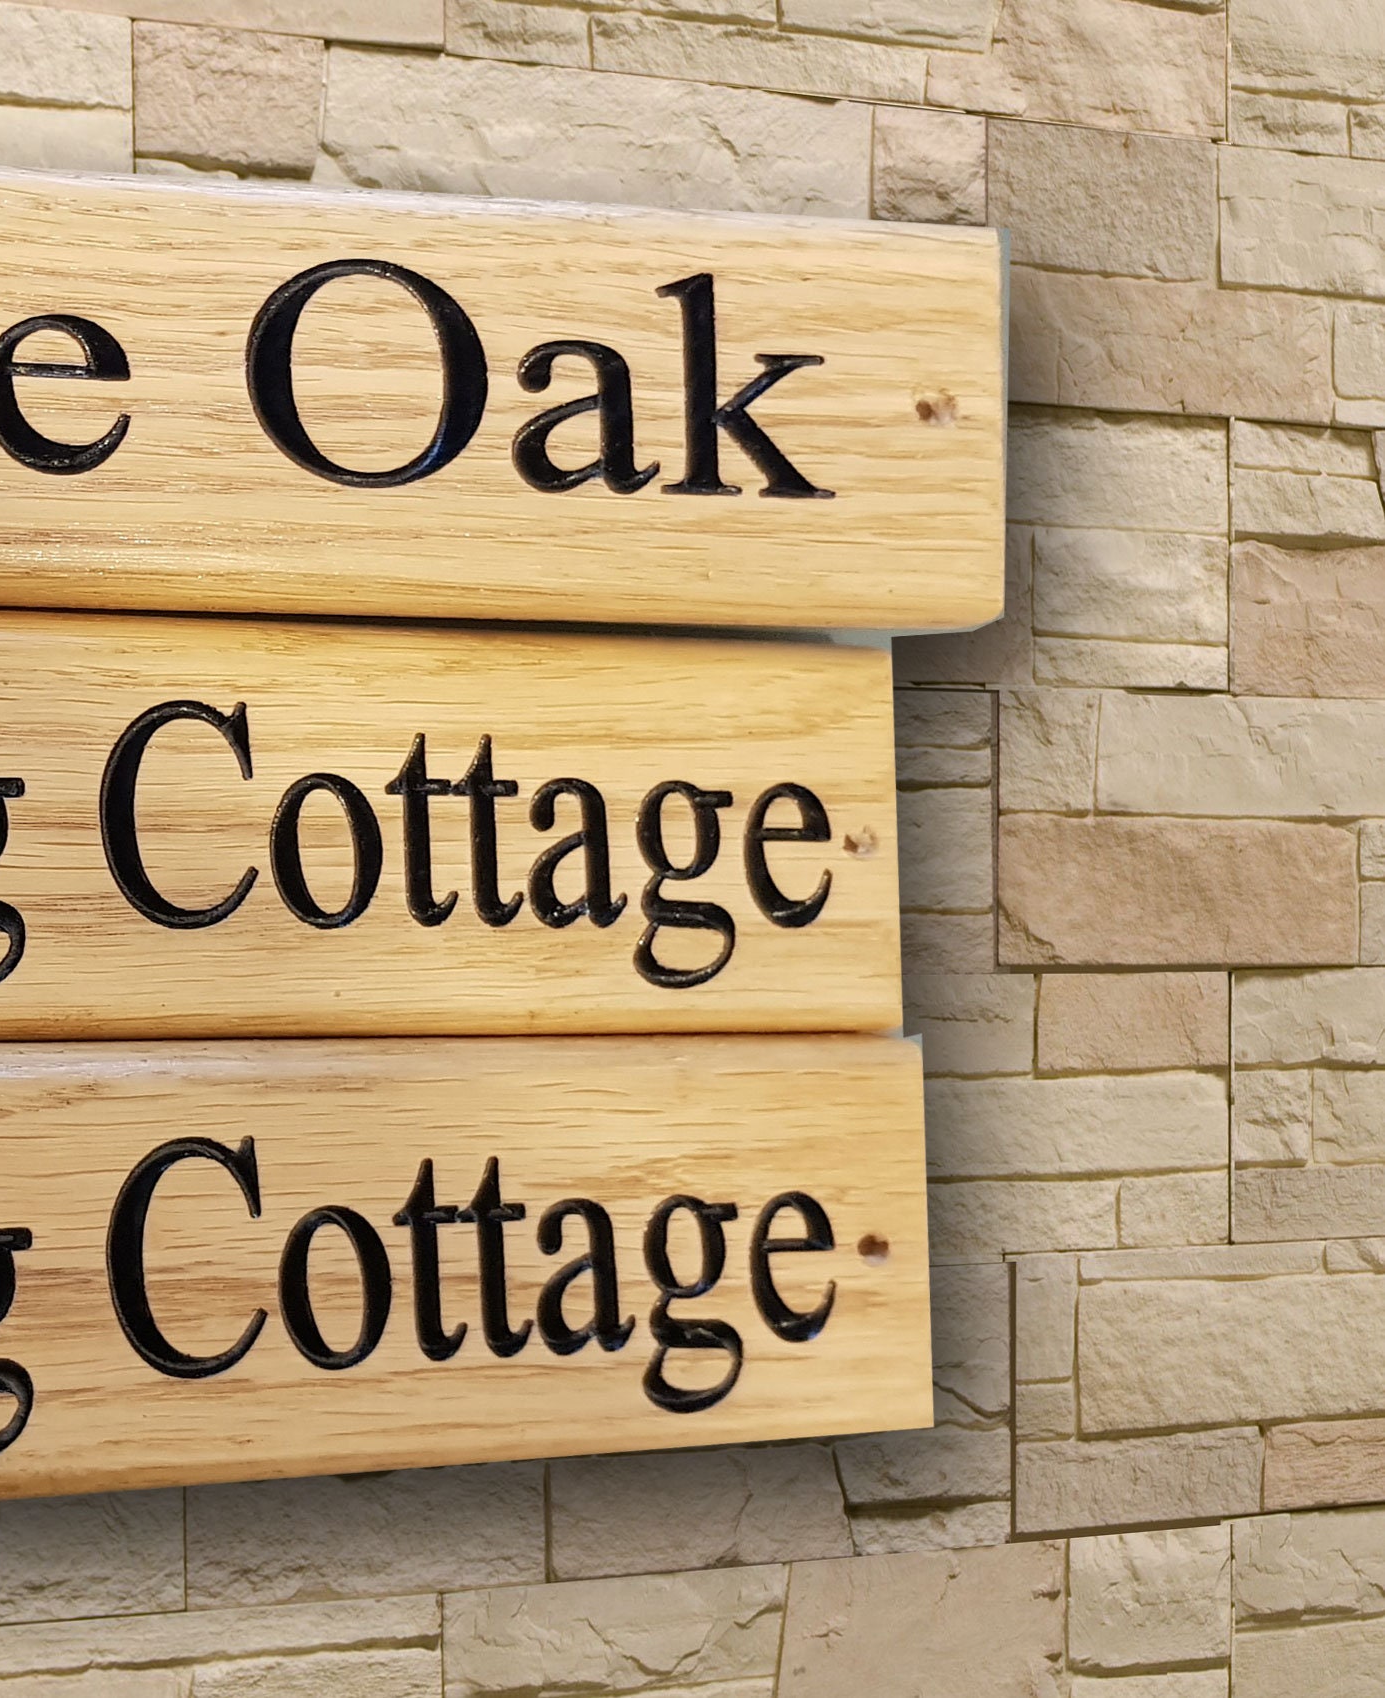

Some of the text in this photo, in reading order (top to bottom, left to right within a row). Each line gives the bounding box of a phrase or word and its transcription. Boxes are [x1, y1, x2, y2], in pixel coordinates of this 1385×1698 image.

[245, 258, 836, 499] Oak
[99, 699, 832, 989] Cottage
[106, 1135, 835, 1414] Cottage
